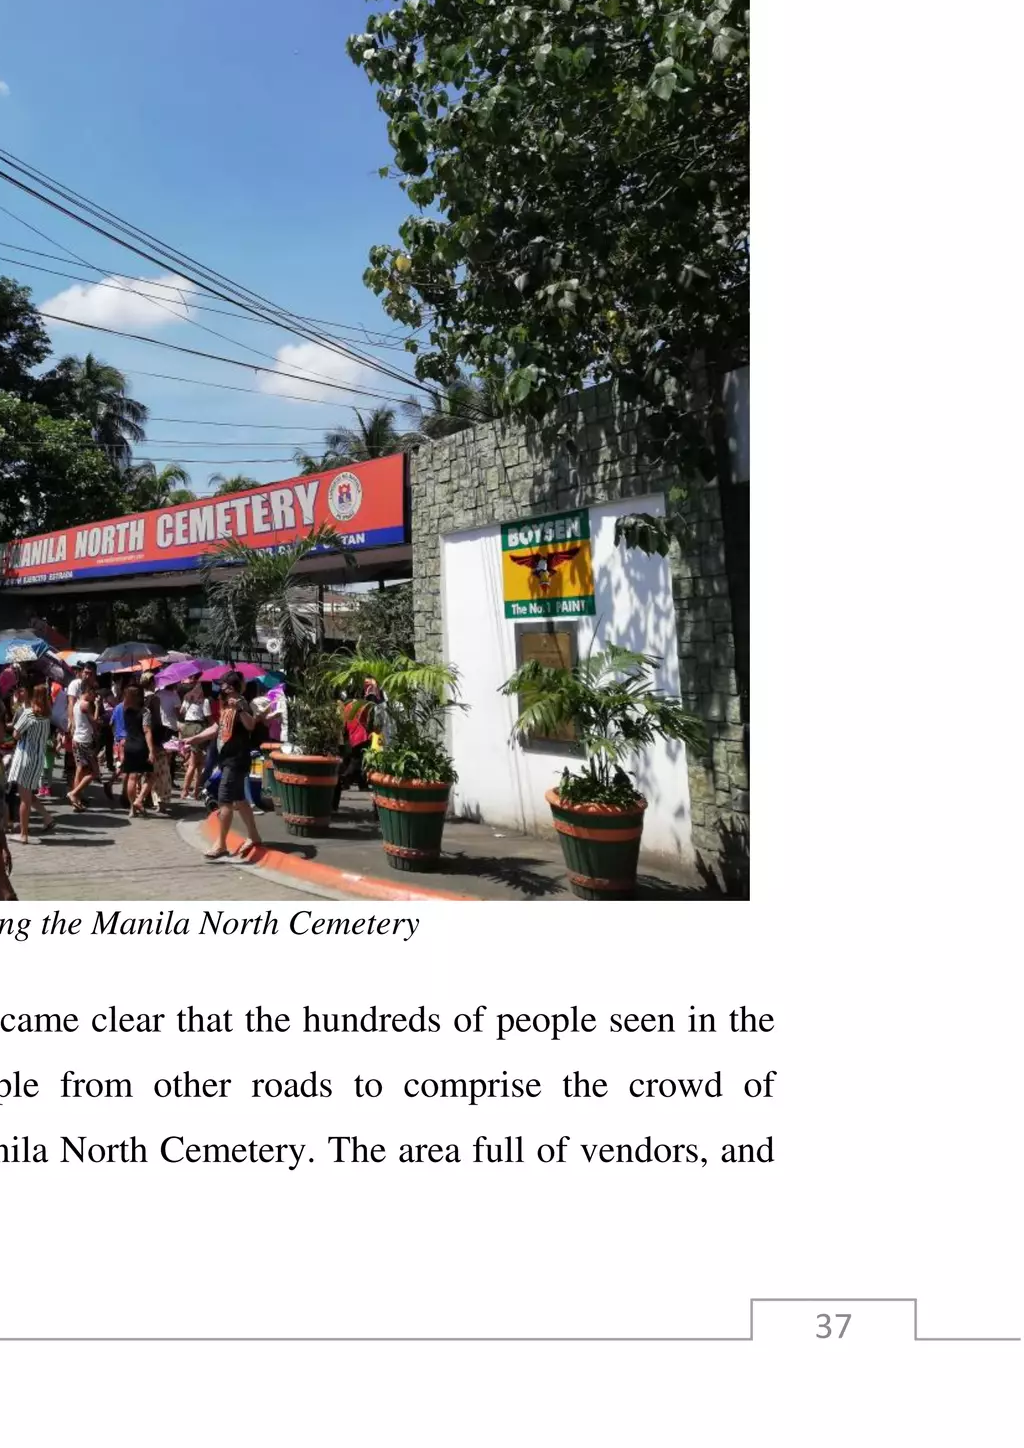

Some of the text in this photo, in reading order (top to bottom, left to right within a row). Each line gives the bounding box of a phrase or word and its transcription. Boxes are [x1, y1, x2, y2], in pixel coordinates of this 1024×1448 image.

[74, 518, 146, 560] NORTH
[155, 480, 321, 549] CEMETERY
[507, 517, 581, 547] BOYSEN
[511, 603, 528, 615] The
[556, 599, 585, 613] PAINT
[41, 910, 82, 935] the
[90, 909, 190, 935] Manila
[198, 909, 279, 935] North
[289, 910, 420, 942] Cemetery
[91, 1005, 166, 1033] clear
[176, 1005, 234, 1033] that
[244, 1005, 291, 1033] the
[302, 1005, 441, 1033] hundreds
[453, 1005, 488, 1033] of
[496, 1005, 597, 1041] people
[610, 1013, 676, 1033] seen
[688, 1005, 717, 1033] in
[728, 1005, 775, 1033] the
[60, 1070, 134, 1098] from
[153, 1070, 232, 1098] other
[251, 1070, 333, 1098] roads
[353, 1074, 383, 1098] to
[403, 1070, 542, 1106] comprise
[562, 1070, 609, 1098] the
[629, 1070, 723, 1098] crowd
[744, 1070, 778, 1098] of
[60, 1135, 148, 1163] North
[160, 1135, 314, 1171] Cemetery.
[327, 1135, 387, 1163] The
[398, 1143, 462, 1163] area
[472, 1135, 525, 1163] full
[537, 1135, 571, 1163] of
[580, 1135, 708, 1168] vendors,
[721, 1135, 775, 1163] and
[815, 1313, 852, 1339] 37
